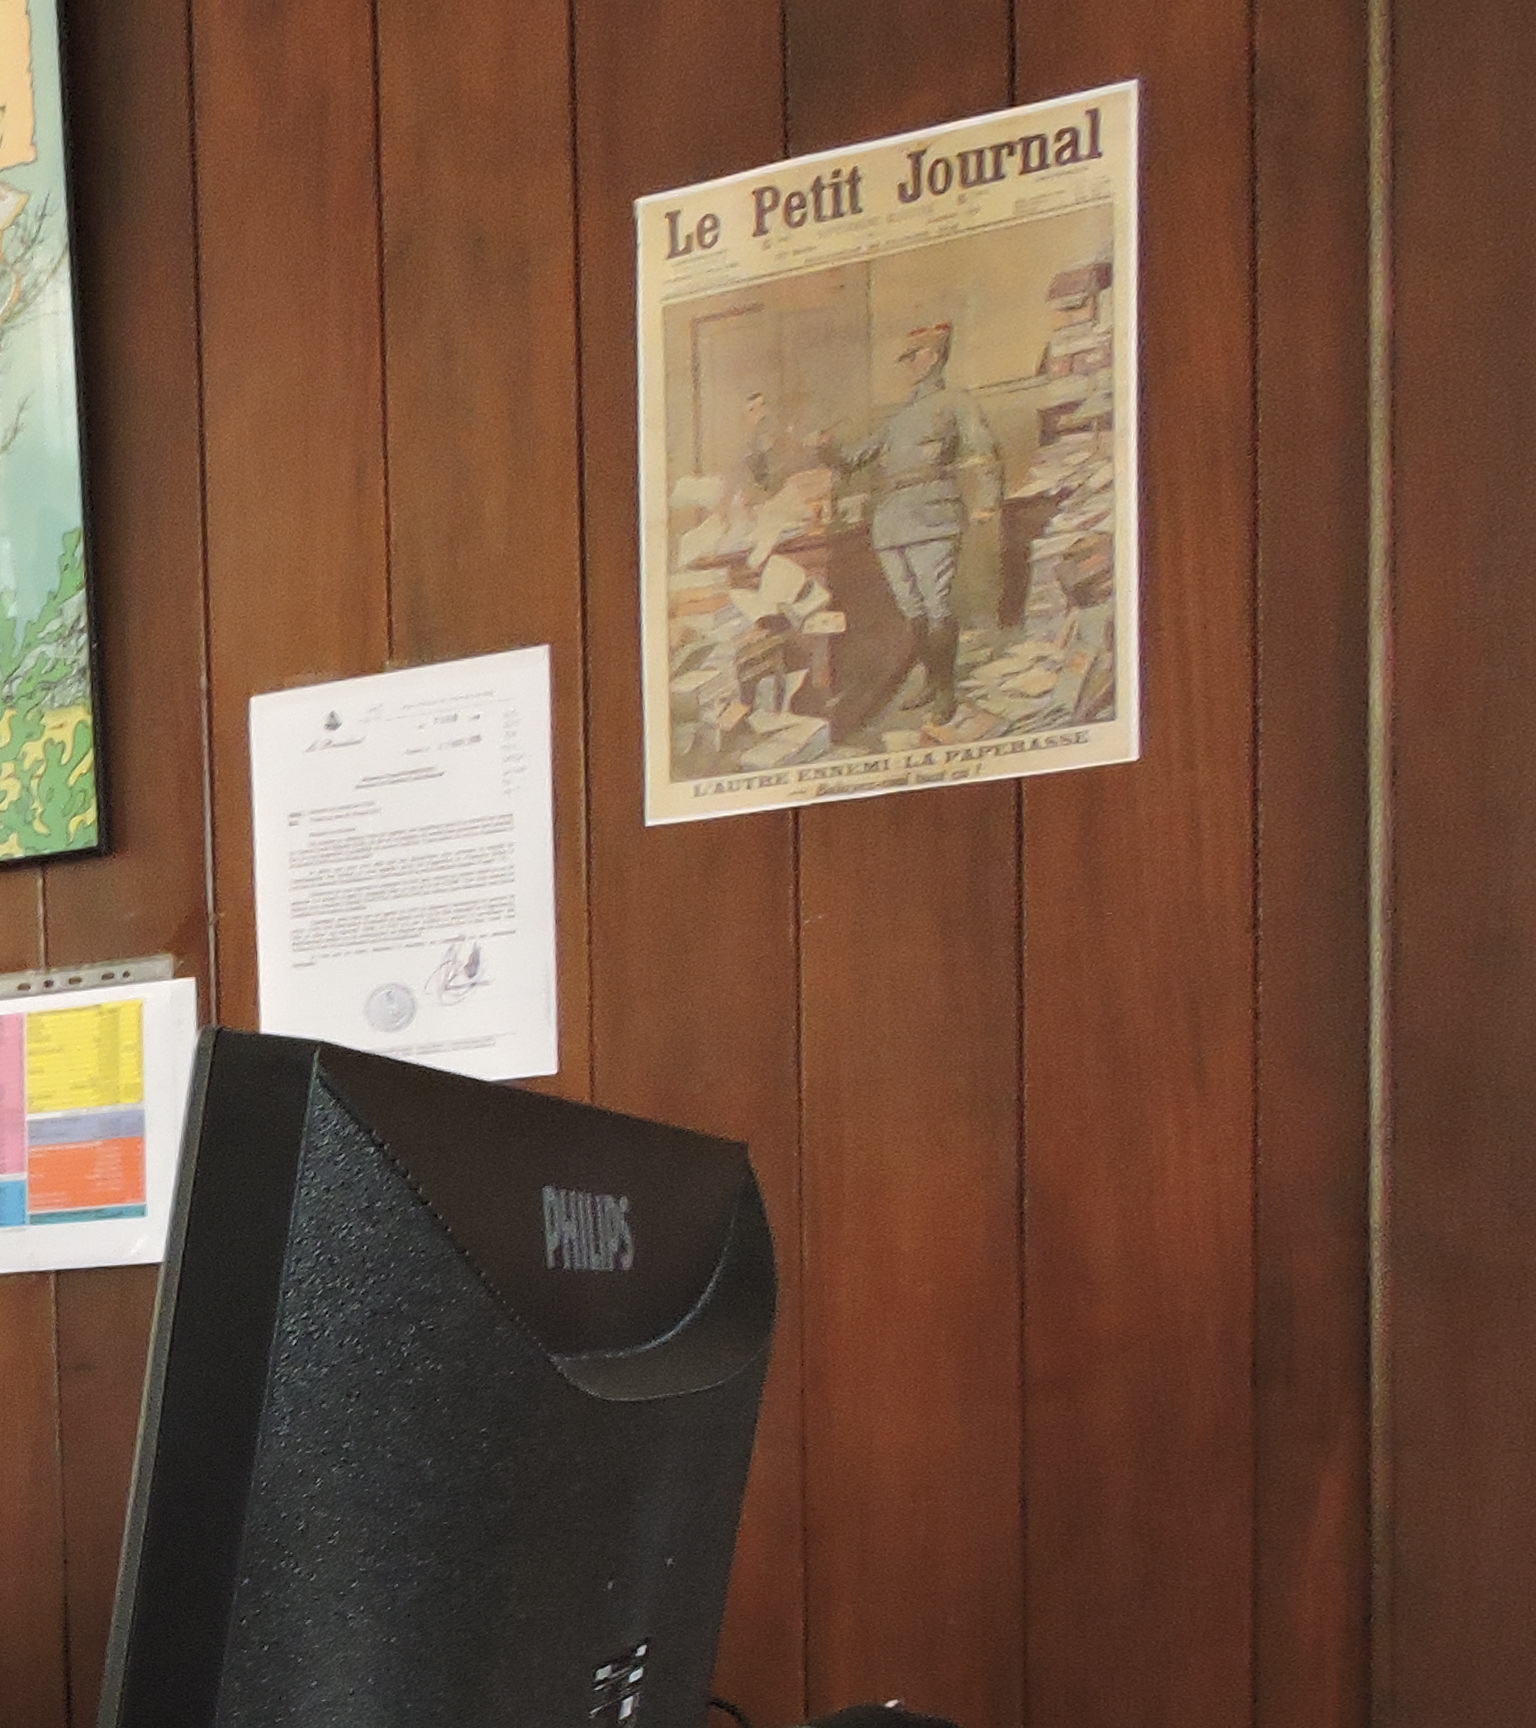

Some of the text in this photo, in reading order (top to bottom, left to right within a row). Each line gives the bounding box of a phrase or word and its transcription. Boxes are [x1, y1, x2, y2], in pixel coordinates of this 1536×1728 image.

[665, 209, 720, 260] Le
[751, 164, 864, 239] Petit
[898, 107, 1103, 205] Journal
[797, 756, 890, 784] ENNEMI
[903, 751, 934, 770] LA
[944, 730, 1090, 764] PAPERASSE
[541, 1184, 634, 1272] PHILIPS
